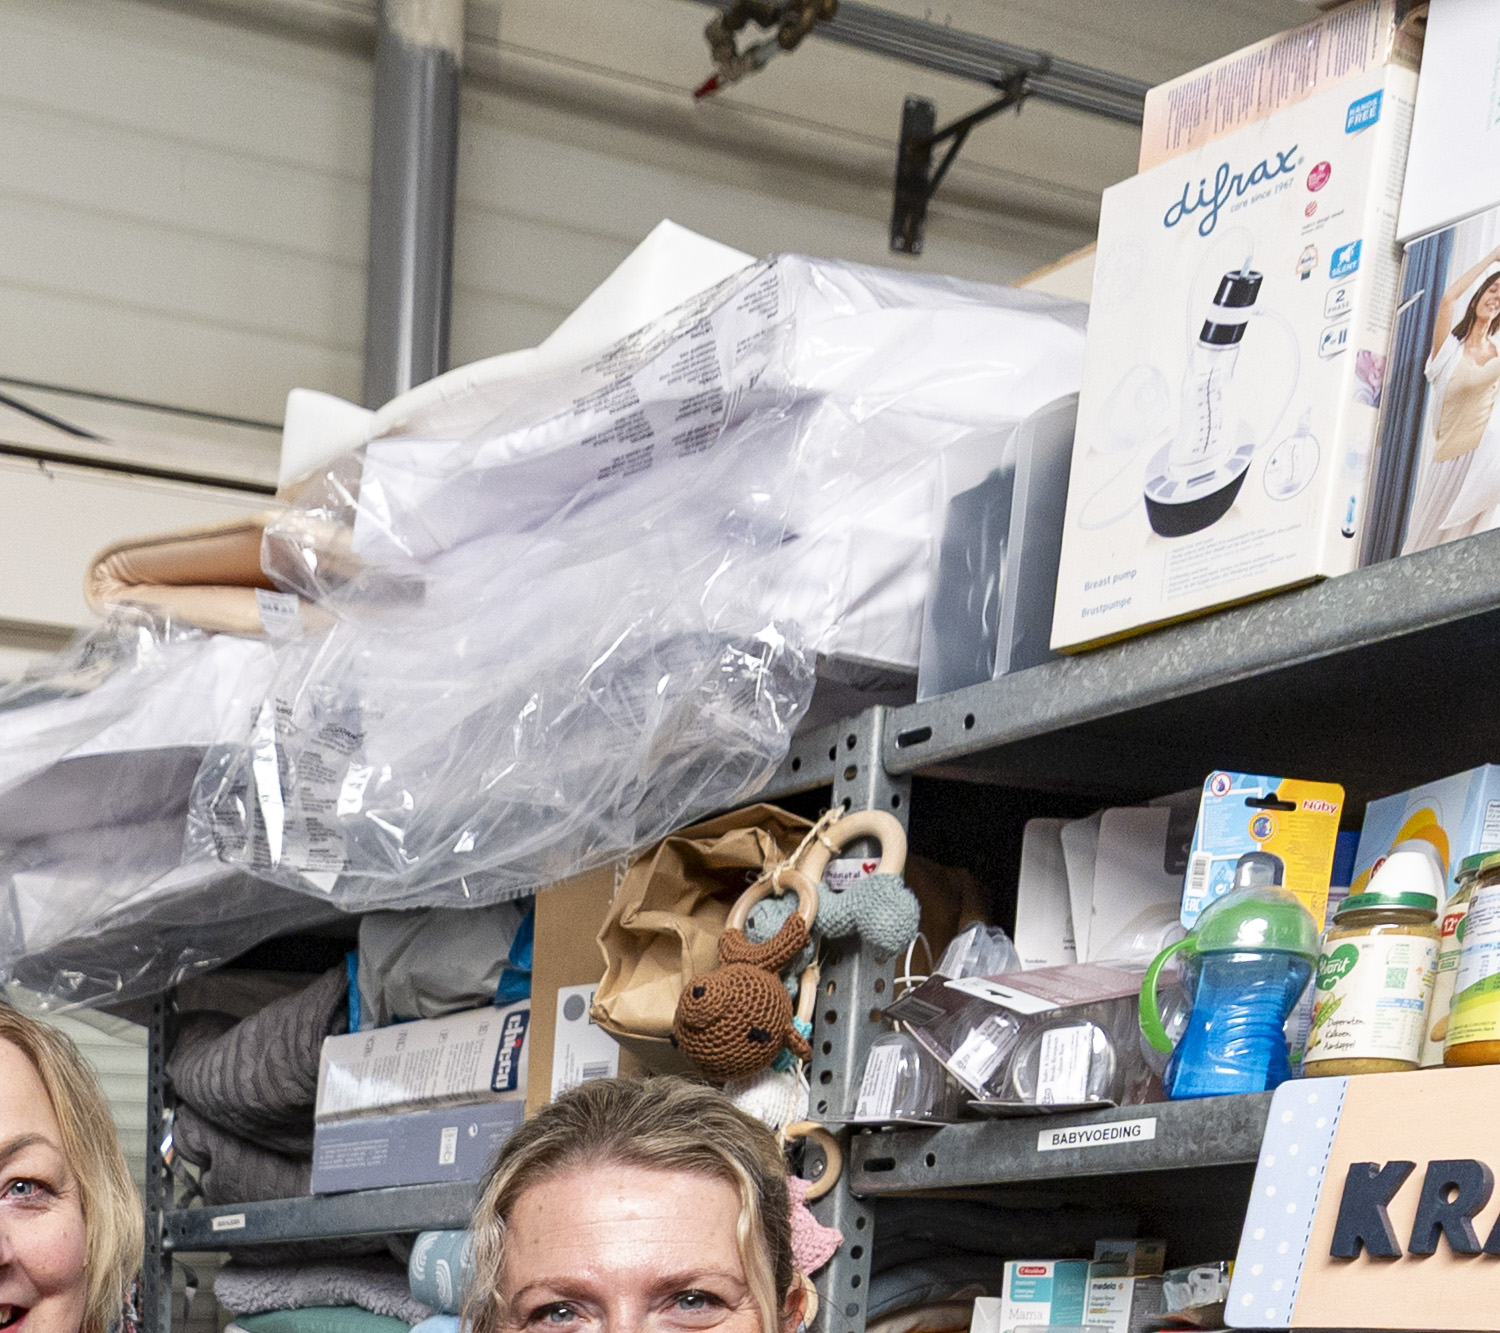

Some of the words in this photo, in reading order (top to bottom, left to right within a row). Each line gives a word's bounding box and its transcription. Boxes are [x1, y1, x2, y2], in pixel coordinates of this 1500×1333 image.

[1347, 107, 1377, 128] FREE
[1164, 144, 1299, 237] difrax
[1329, 260, 1359, 279] SILENT
[1334, 289, 1346, 303] 2
[1084, 572, 1112, 592] Breast
[1112, 568, 1138, 587] pump
[1081, 596, 1133, 619] Brustpumpe
[496, 1015, 523, 1088] chicco
[1051, 1124, 1142, 1146] BABYVOEDING
[1092, 1282, 1117, 1292] medela
[1008, 1307, 1043, 1322] Mama
